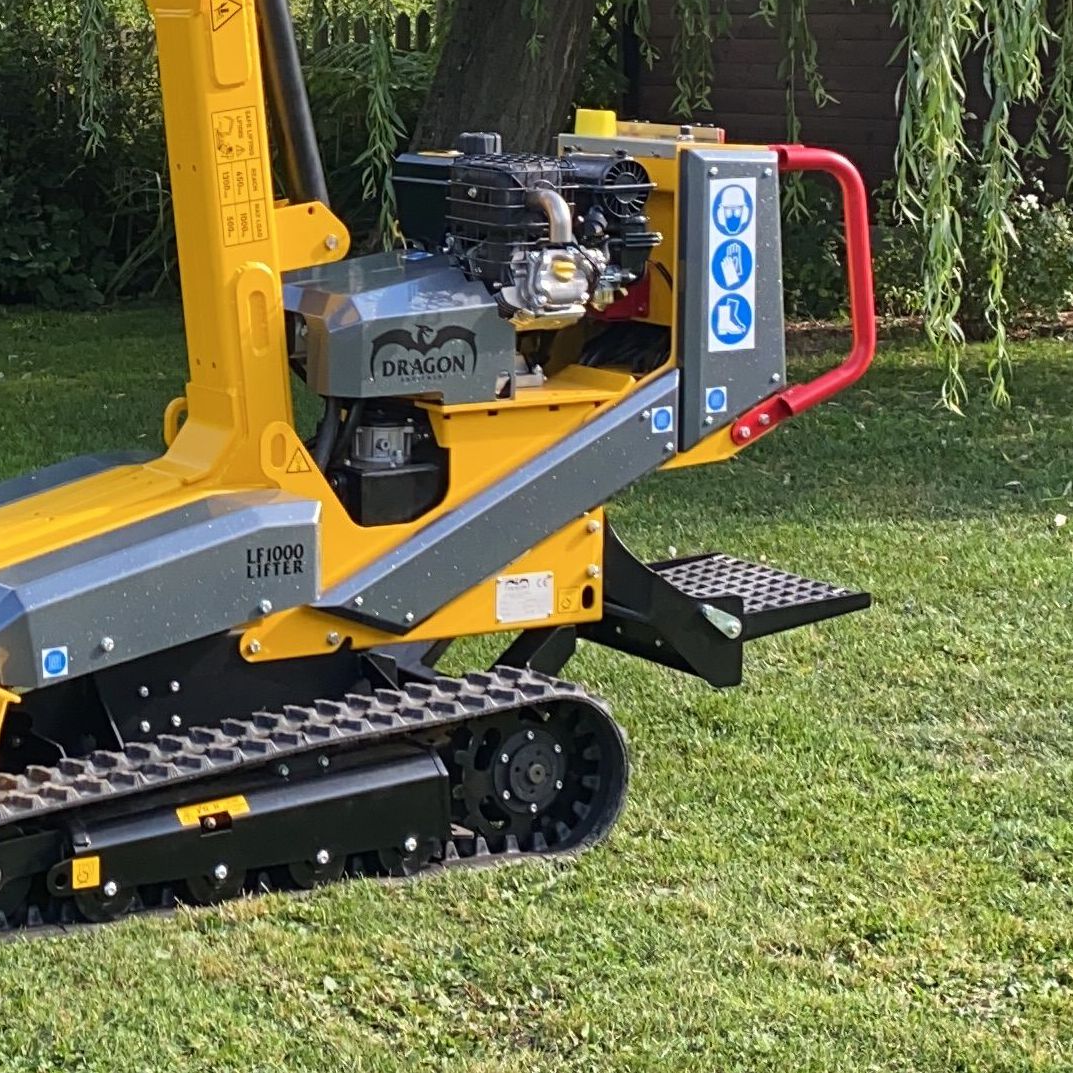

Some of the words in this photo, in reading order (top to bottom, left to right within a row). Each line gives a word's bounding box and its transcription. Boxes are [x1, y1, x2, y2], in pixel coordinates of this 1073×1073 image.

[382, 355, 466, 377] DRAGON
[246, 543, 304, 564] LF1000
[246, 560, 304, 579] LIFTER
